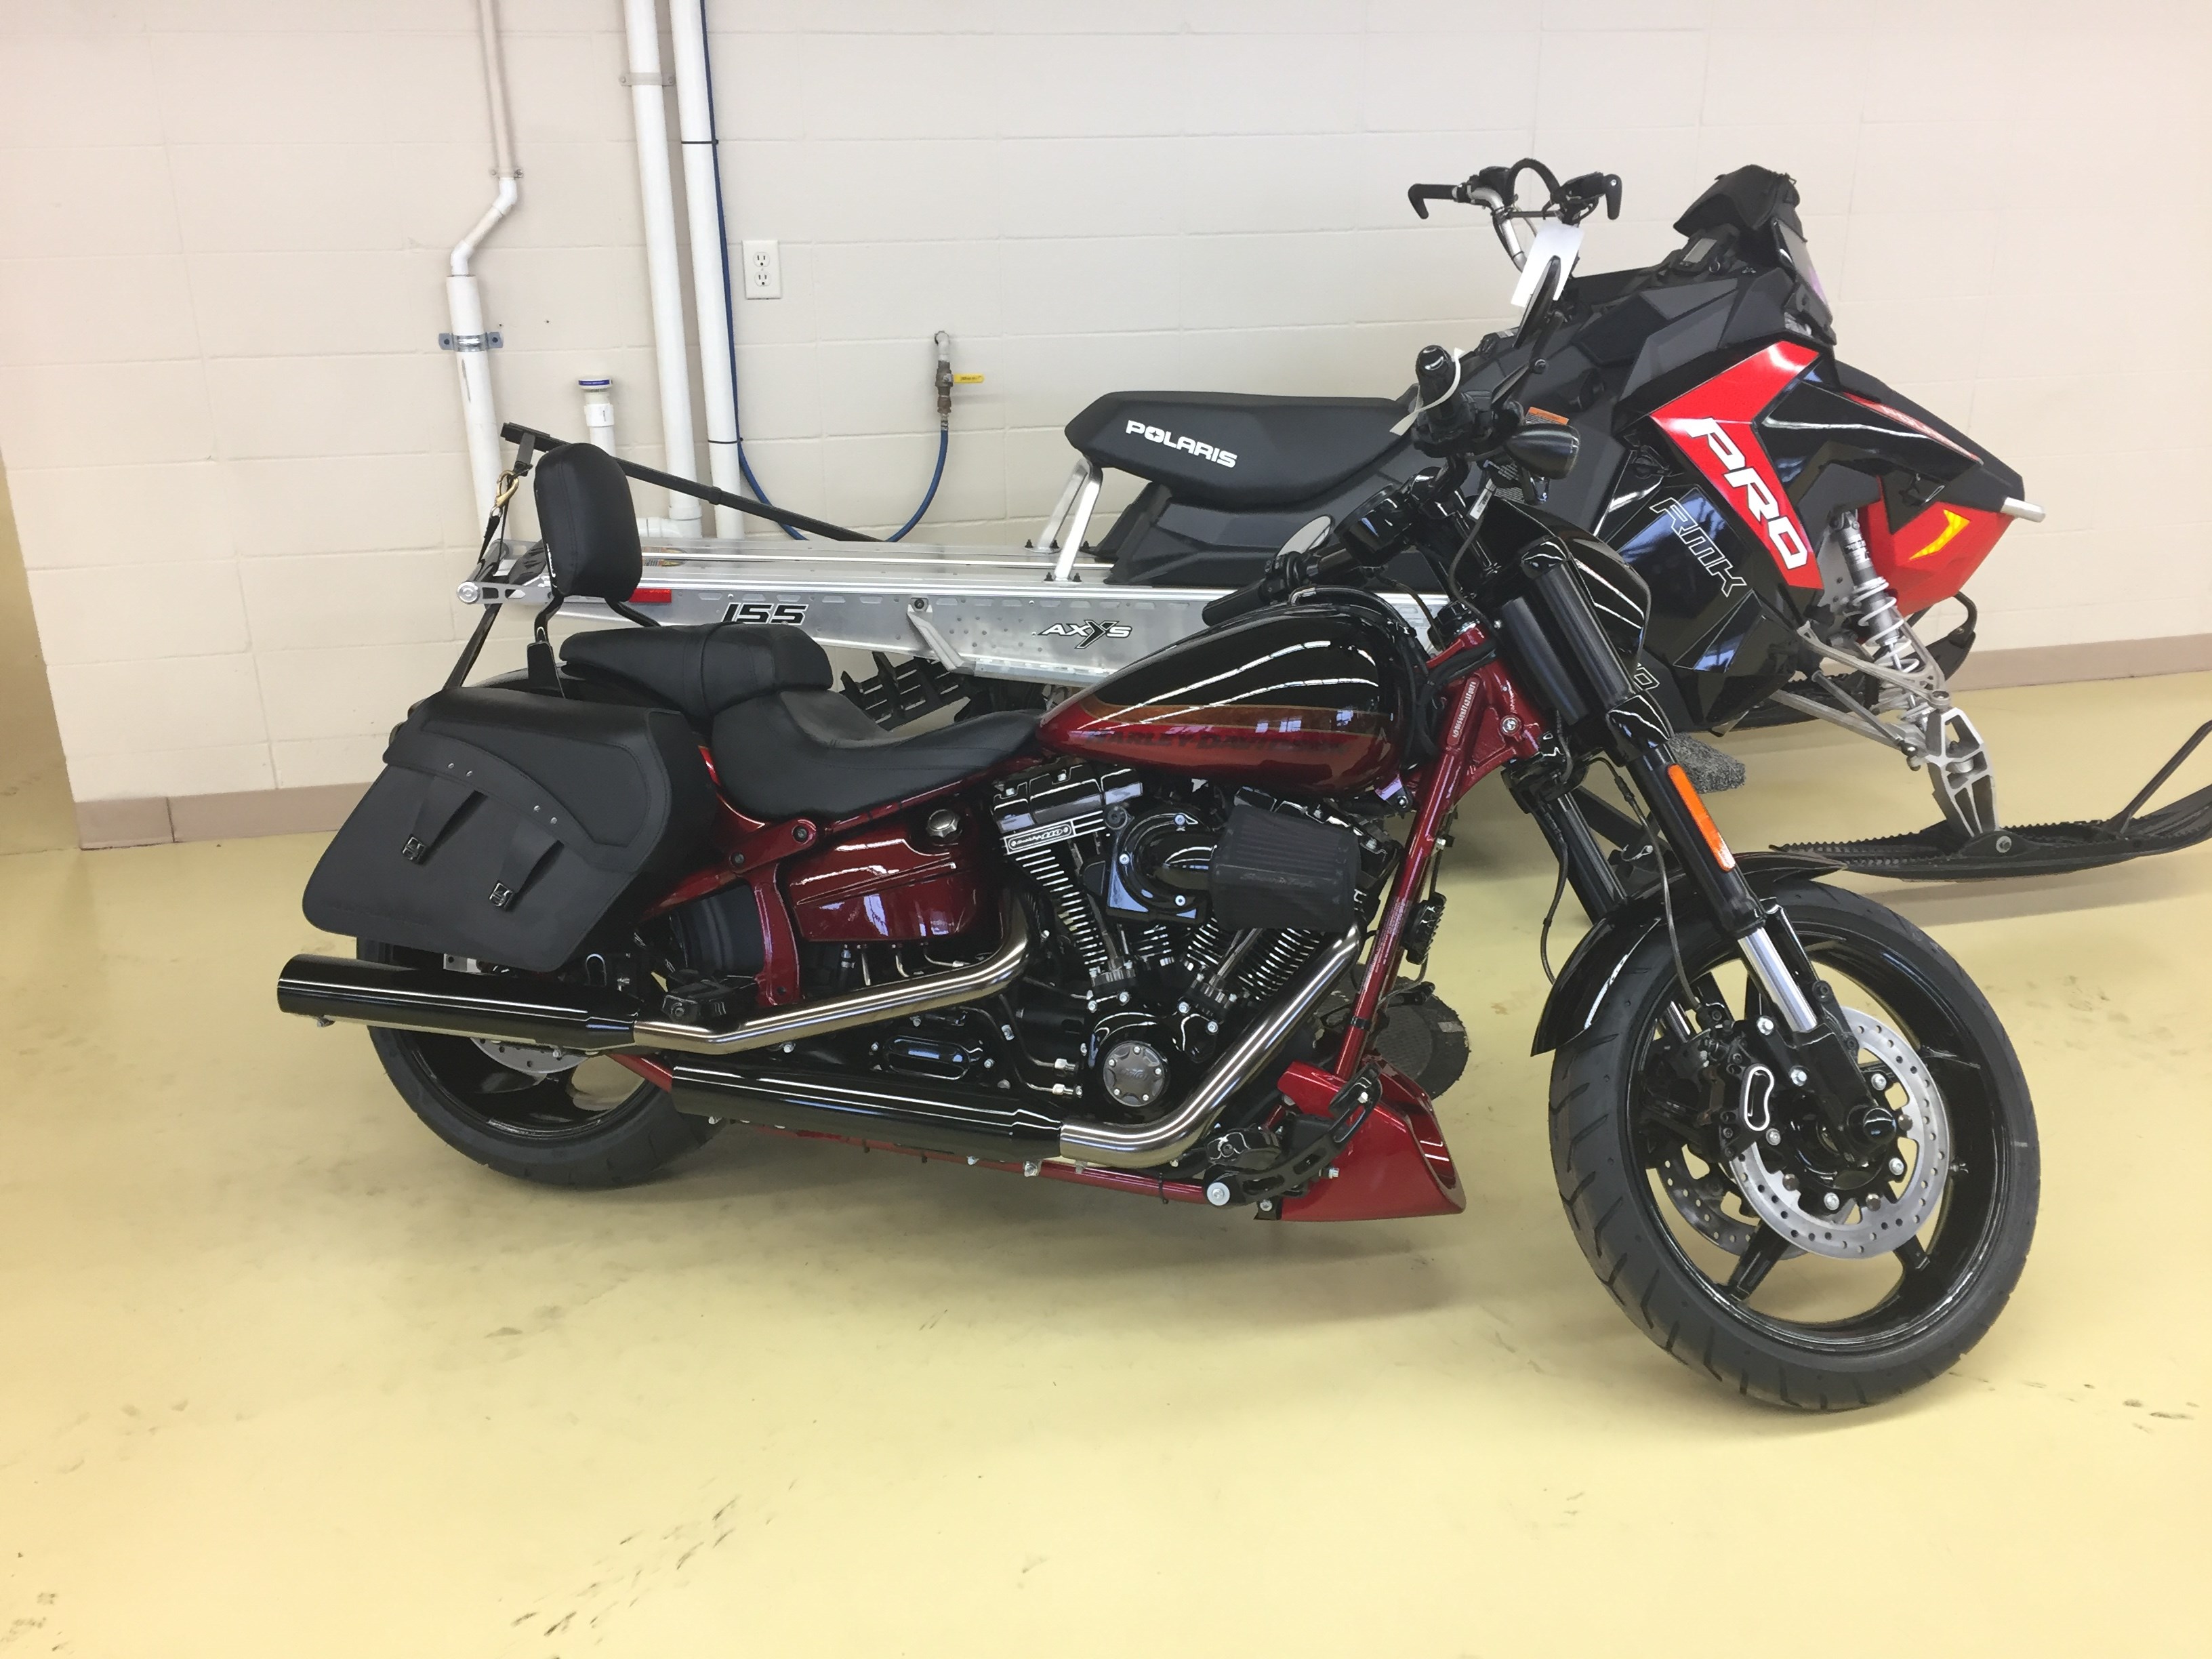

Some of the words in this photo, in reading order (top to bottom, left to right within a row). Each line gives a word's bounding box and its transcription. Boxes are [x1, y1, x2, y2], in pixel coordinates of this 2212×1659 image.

[1126, 419, 1237, 468] POLARIS
[1685, 417, 1809, 570] PRO
[1650, 497, 1747, 597] RMK
[721, 602, 808, 625] 155
[1038, 619, 1132, 649] AXYS
